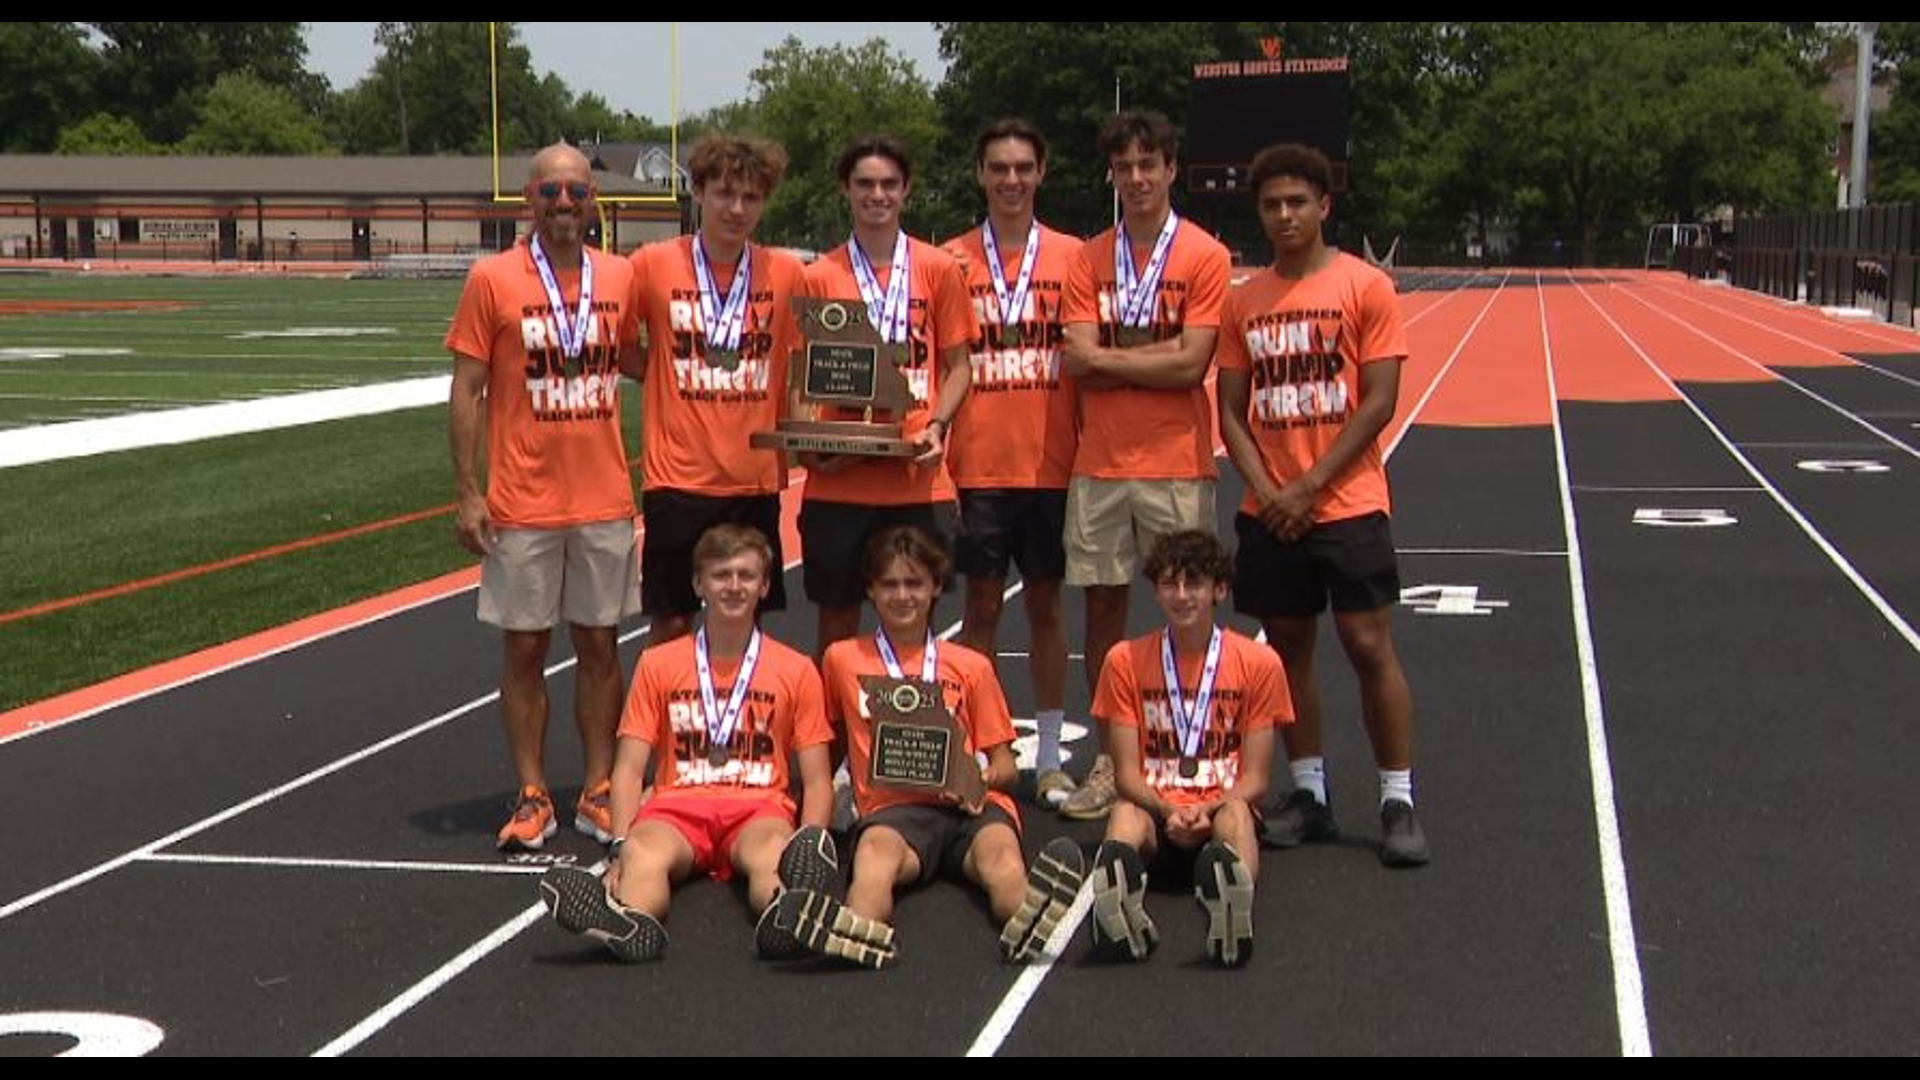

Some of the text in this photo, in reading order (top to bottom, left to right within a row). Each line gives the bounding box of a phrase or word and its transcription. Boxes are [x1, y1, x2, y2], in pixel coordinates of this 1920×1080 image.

[1247, 308, 1344, 330] STATESMEN
[1245, 320, 1311, 362] RUN
[1252, 351, 1346, 390] JUMP
[1254, 379, 1348, 421] THROW
